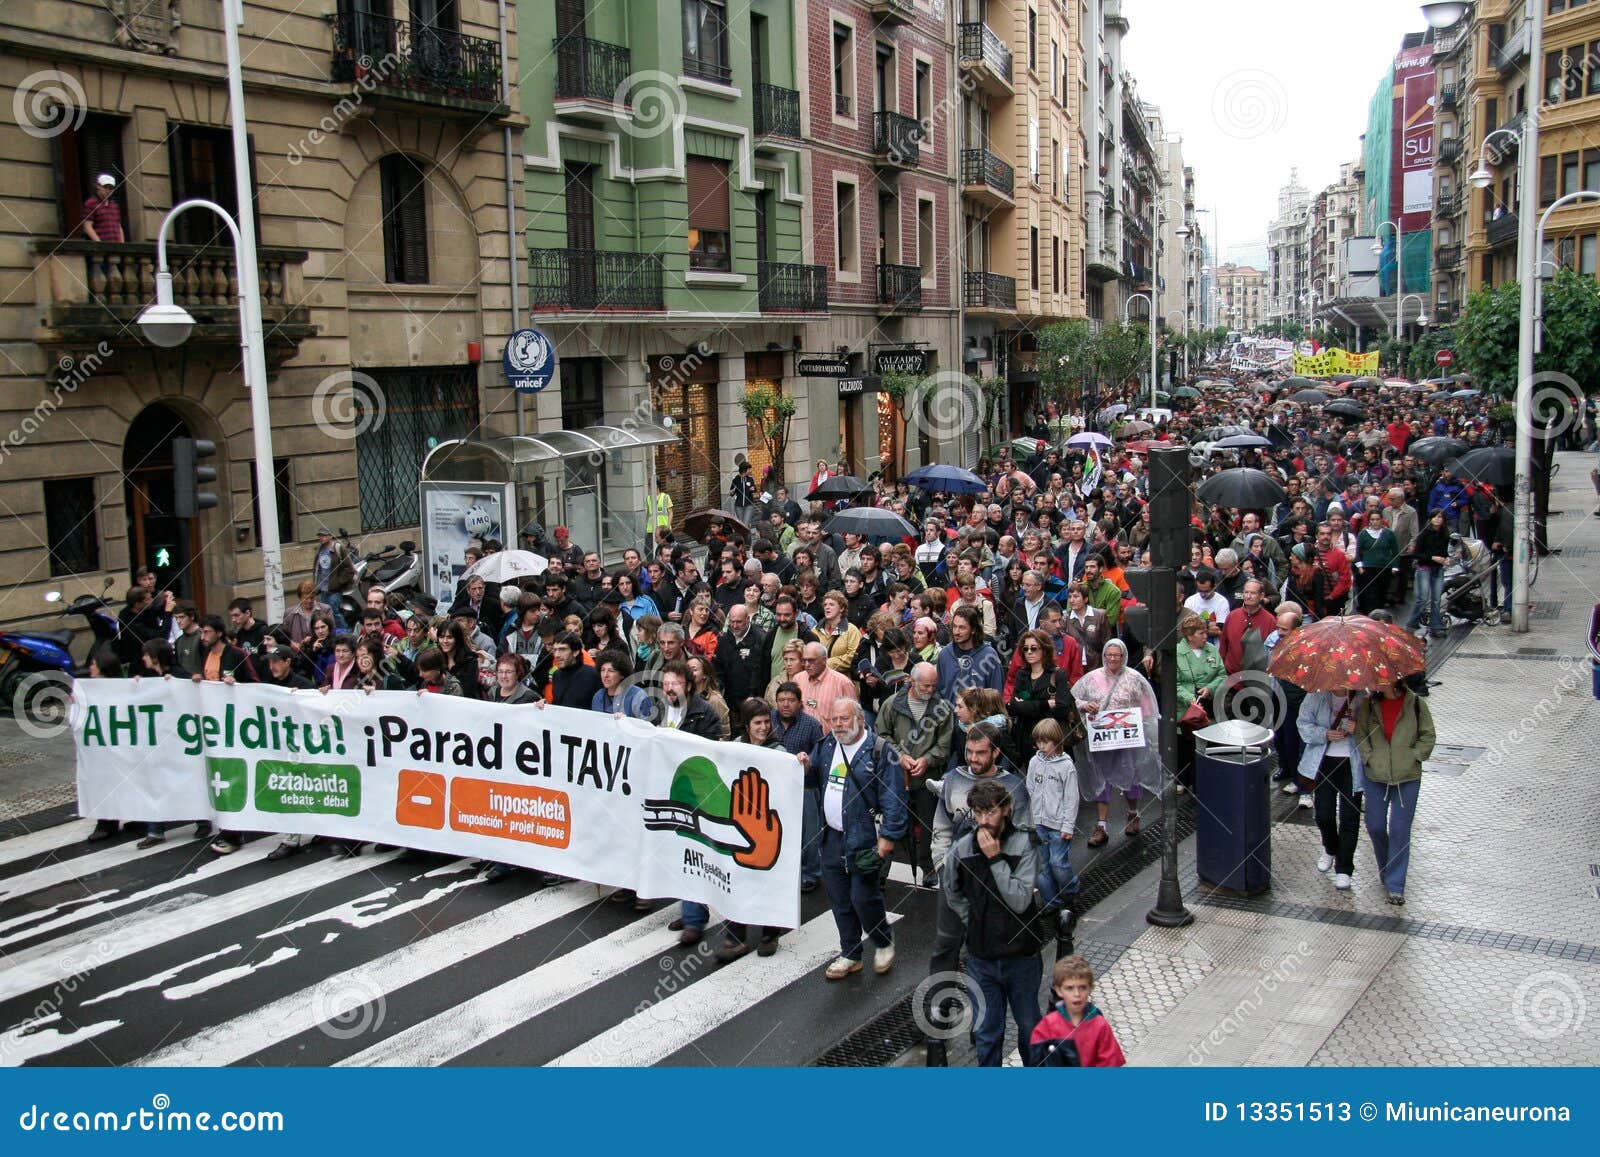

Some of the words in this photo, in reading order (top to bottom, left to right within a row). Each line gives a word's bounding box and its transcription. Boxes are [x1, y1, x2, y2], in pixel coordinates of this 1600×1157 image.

[878, 355, 922, 364] CALZADOS
[515, 377, 543, 388] unicef
[840, 380, 863, 392] CALZADOS
[1093, 730, 1118, 742] AHT
[1123, 729, 1139, 739] EZ
[83, 704, 163, 746] AHT
[177, 704, 347, 756] gelditu!
[363, 715, 503, 767] ¡Parad
[516, 729, 552, 778] el
[560, 734, 632, 796] TAV!
[268, 772, 348, 793] eztabaida
[281, 794, 315, 805] debate
[324, 795, 350, 808] débat
[489, 788, 566, 822] inposaketa
[458, 811, 503, 829] imposición
[510, 819, 535, 834] projet
